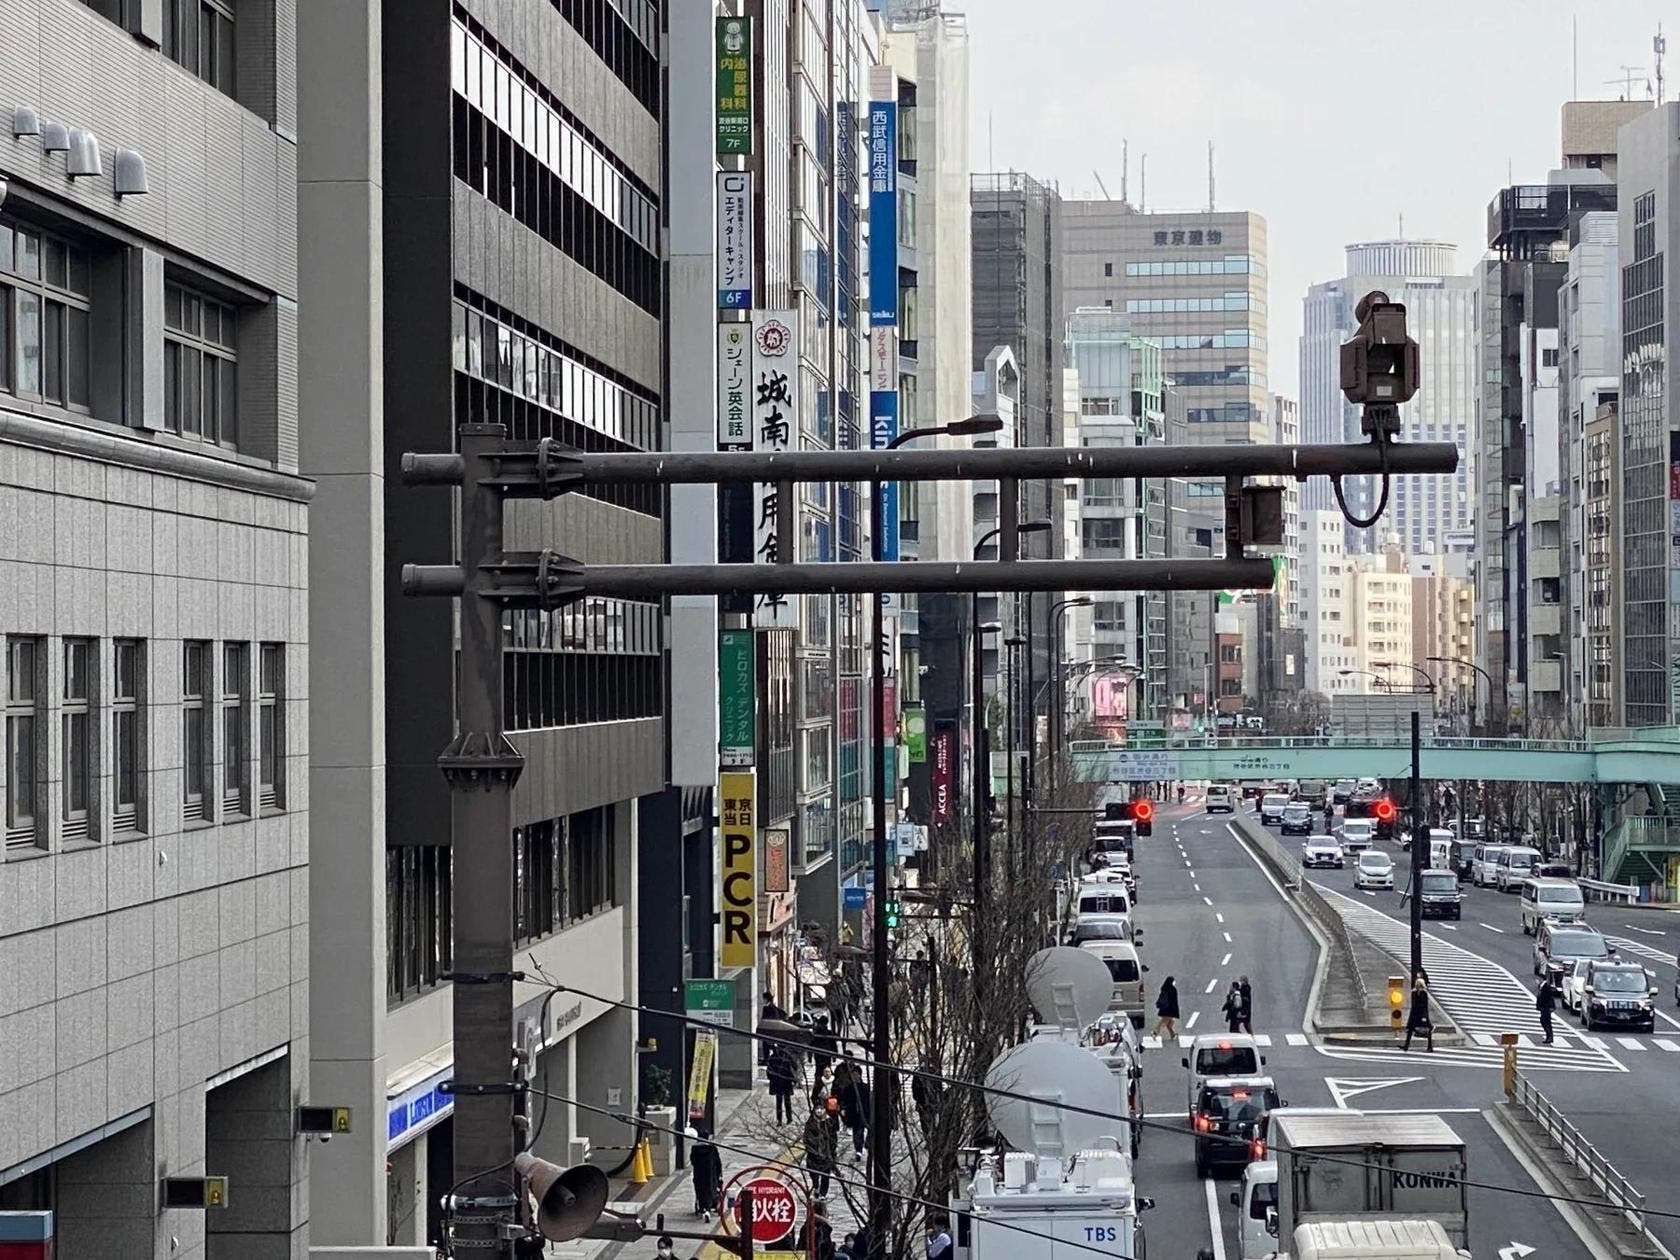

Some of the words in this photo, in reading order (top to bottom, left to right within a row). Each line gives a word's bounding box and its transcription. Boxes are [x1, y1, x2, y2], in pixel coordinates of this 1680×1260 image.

[726, 139, 741, 148] 7F
[872, 111, 887, 193] 西武信用金庫
[1153, 229, 1222, 246] 東京建物
[726, 292, 742, 303] 6F
[728, 348, 743, 437] シェーン英会話
[723, 798, 752, 811] 東京
[938, 784, 946, 815] ACCEA
[723, 812, 751, 826] 当日
[723, 834, 753, 945] PCR
[1084, 1227, 1117, 1242] TBS
